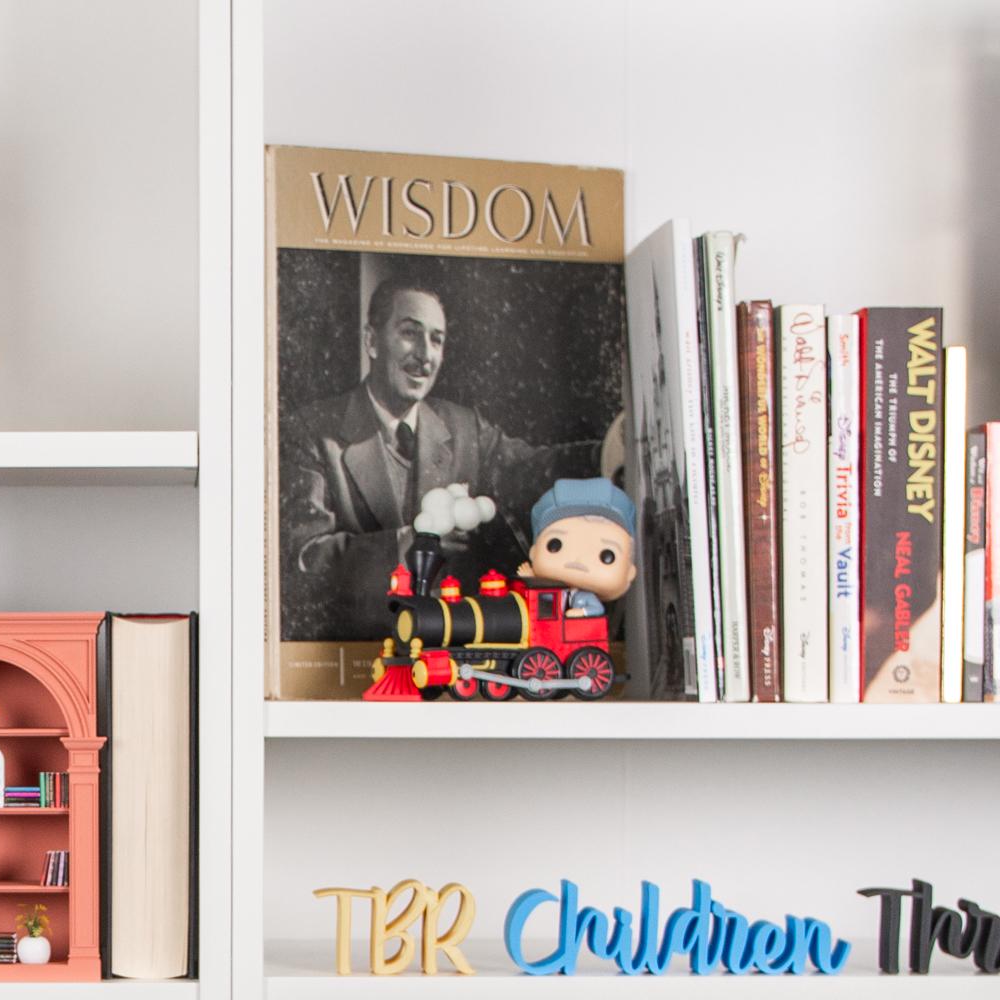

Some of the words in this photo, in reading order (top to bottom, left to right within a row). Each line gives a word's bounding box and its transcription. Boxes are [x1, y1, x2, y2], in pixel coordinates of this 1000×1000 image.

[308, 171, 594, 248] WISDOM
[874, 338, 884, 360] THE
[907, 317, 937, 405] WALT
[756, 344, 768, 413] WONDERFUL
[873, 362, 884, 419] AMERICAN
[888, 373, 898, 394] THE
[757, 414, 769, 458] WORLD
[832, 416, 852, 461] Disney
[887, 397, 898, 446] TRIUMPH
[872, 421, 884, 498] IMAGINATION
[887, 448, 898, 463] OF
[906, 410, 937, 523] DISNEY
[756, 472, 772, 508] Disney
[836, 463, 853, 519] Trivia
[837, 547, 853, 599] Vault
[894, 530, 912, 579] NEAL
[760, 626, 775, 656] Disney
[893, 583, 913, 653] GABLER
[763, 656, 772, 687] PRESS
[312, 879, 477, 976] TBR
[503, 878, 852, 977] Children
